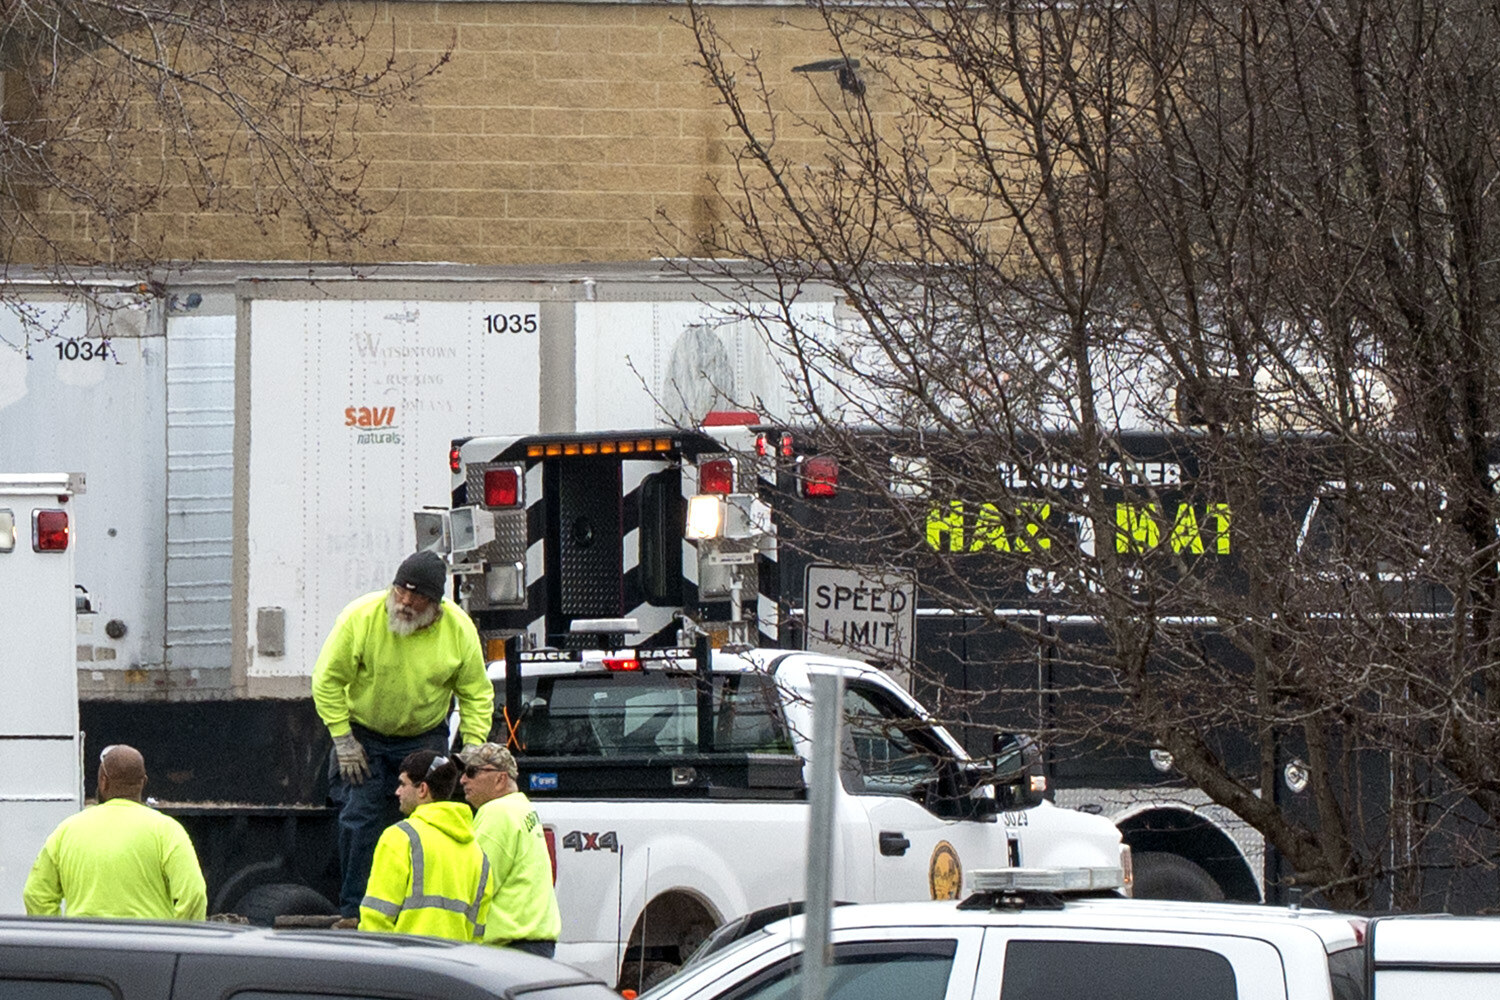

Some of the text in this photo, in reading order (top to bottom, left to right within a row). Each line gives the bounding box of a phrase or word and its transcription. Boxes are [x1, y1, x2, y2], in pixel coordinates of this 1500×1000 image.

[484, 314, 538, 334] 1035
[55, 341, 109, 361] 1034
[357, 432, 402, 445] naturals
[815, 585, 907, 612] SPEED
[824, 619, 895, 647] LIMIT
[519, 649, 691, 661] BACK RACK
